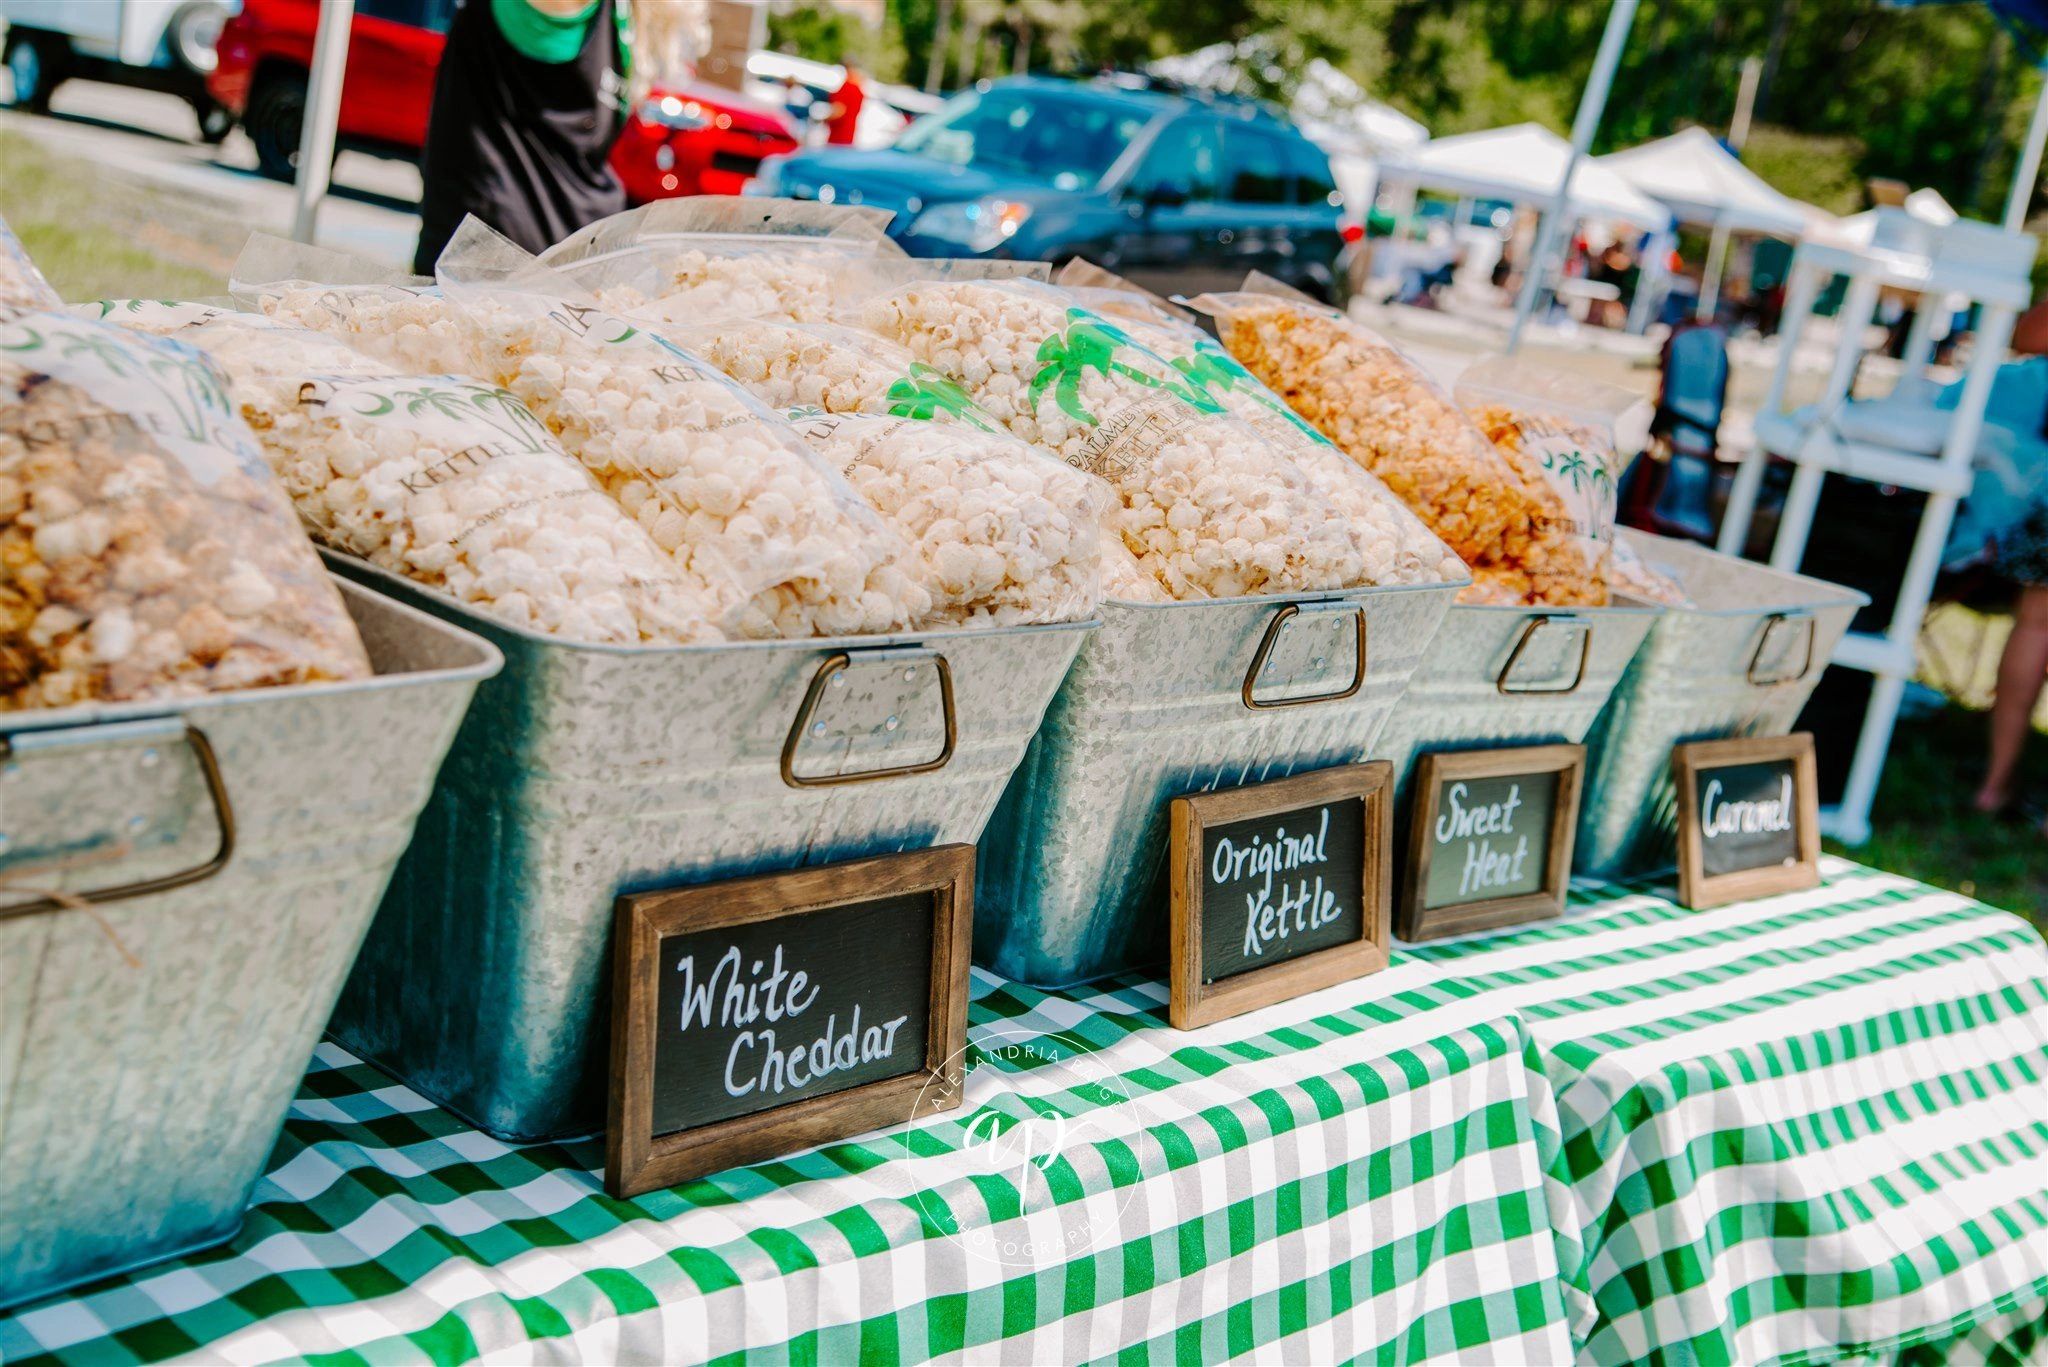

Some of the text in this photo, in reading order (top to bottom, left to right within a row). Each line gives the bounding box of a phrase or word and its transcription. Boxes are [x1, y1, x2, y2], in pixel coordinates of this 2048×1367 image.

[1435, 782, 1522, 844] Sweet
[1702, 774, 1792, 838] Caramel
[1212, 808, 1329, 899] Original
[1459, 835, 1529, 896] Heat
[1243, 876, 1342, 956] Kettle
[677, 944, 820, 1031] White
[724, 1004, 908, 1097] Cheddar
